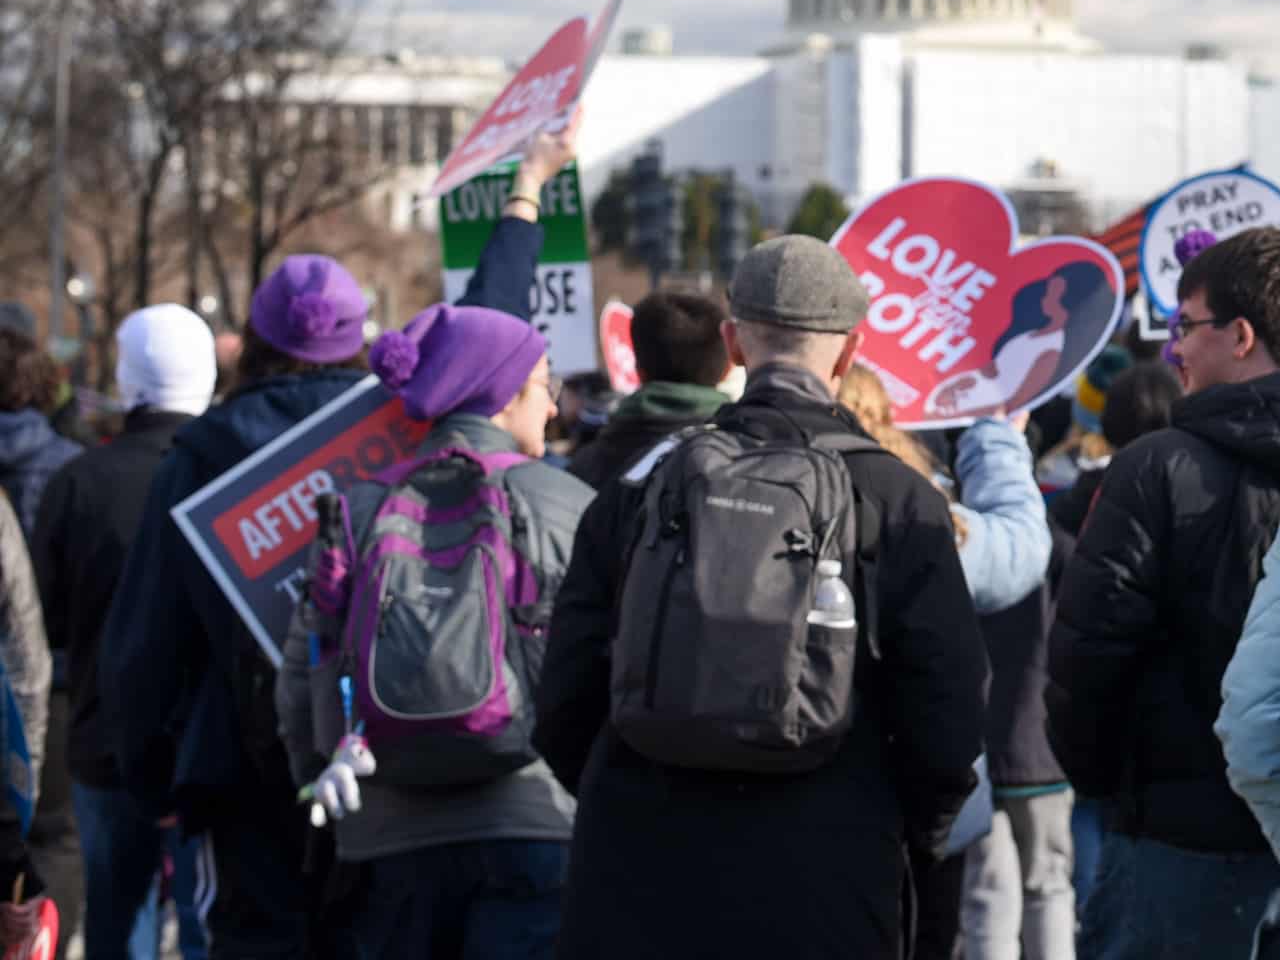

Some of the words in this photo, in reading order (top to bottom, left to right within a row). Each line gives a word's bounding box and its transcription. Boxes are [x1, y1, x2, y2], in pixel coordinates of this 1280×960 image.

[539, 172, 579, 216] IFE
[1177, 181, 1239, 214] PRAY
[1210, 201, 1263, 231] END
[866, 216, 998, 311] LOVE
[527, 269, 577, 316] OSE
[237, 469, 335, 560] AFTER
